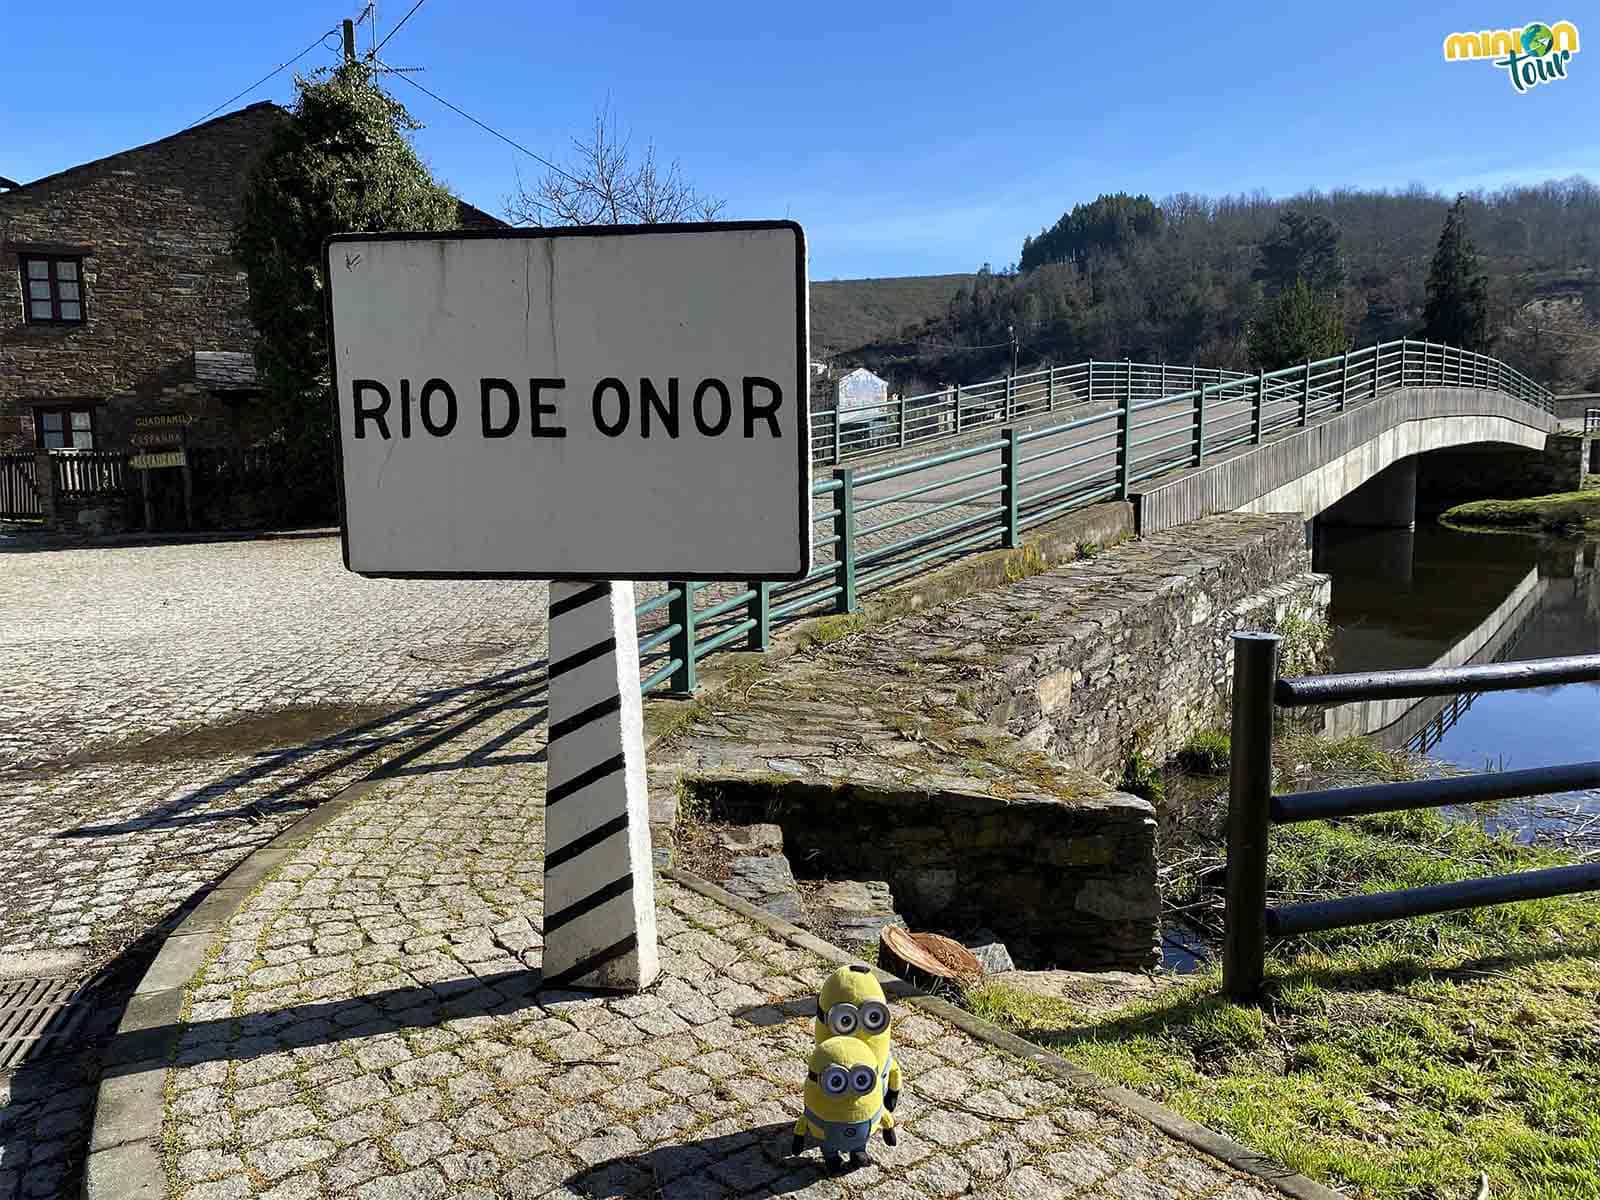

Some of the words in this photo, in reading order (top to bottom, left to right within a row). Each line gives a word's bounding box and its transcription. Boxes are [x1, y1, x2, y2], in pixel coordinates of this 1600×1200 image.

[351, 377, 458, 441] RIO
[479, 377, 568, 440] DE
[591, 375, 784, 440] ONOR
